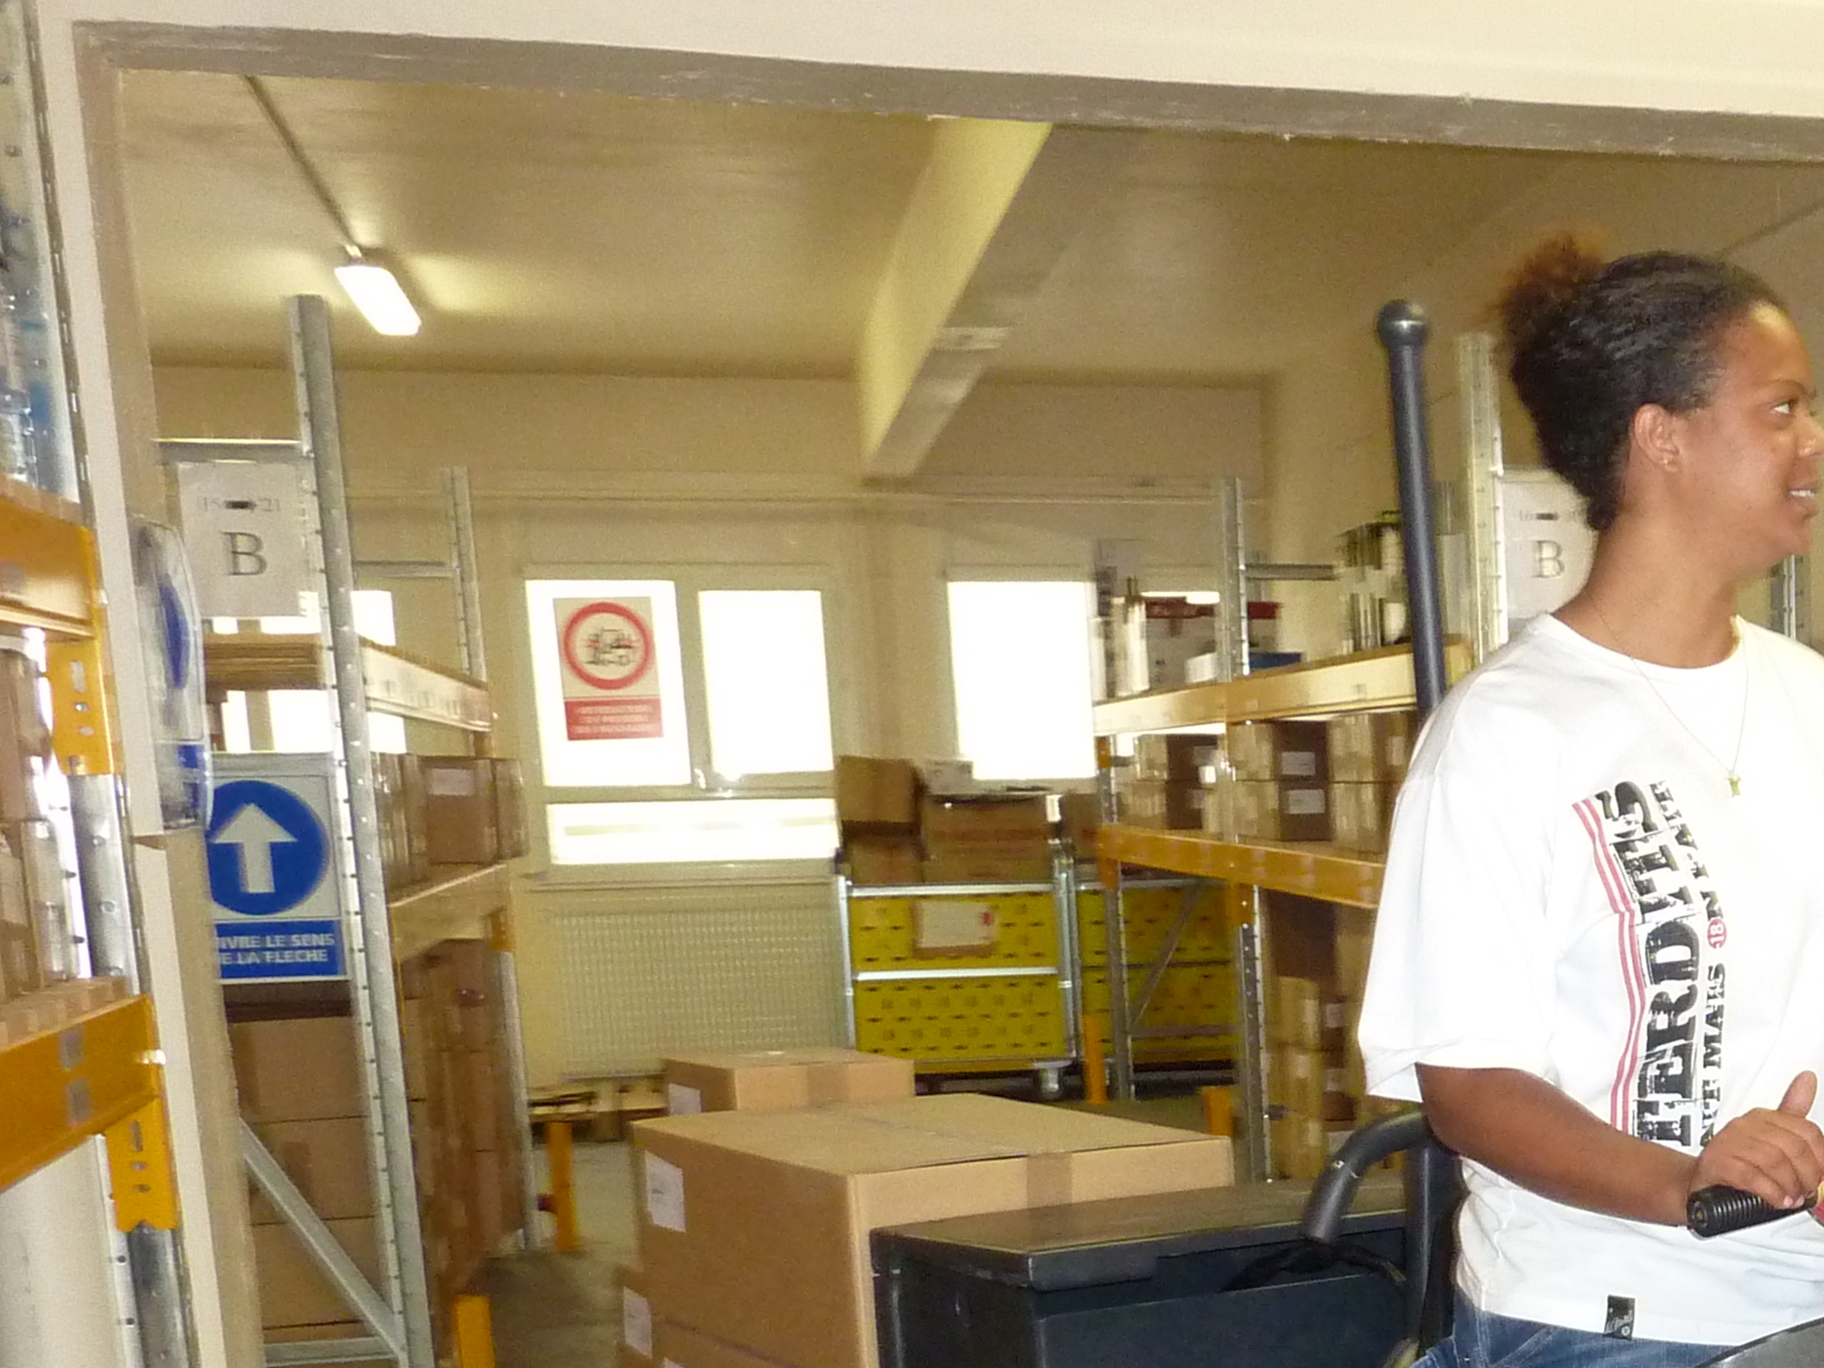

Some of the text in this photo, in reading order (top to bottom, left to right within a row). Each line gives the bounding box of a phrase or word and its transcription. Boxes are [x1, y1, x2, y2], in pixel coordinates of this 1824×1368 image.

[221, 531, 267, 576] B
[1532, 540, 1565, 578] B
[237, 950, 260, 965] LA
[266, 934, 286, 948] LE
[291, 933, 335, 947] SENS
[1595, 781, 1700, 1147] TERDITS
